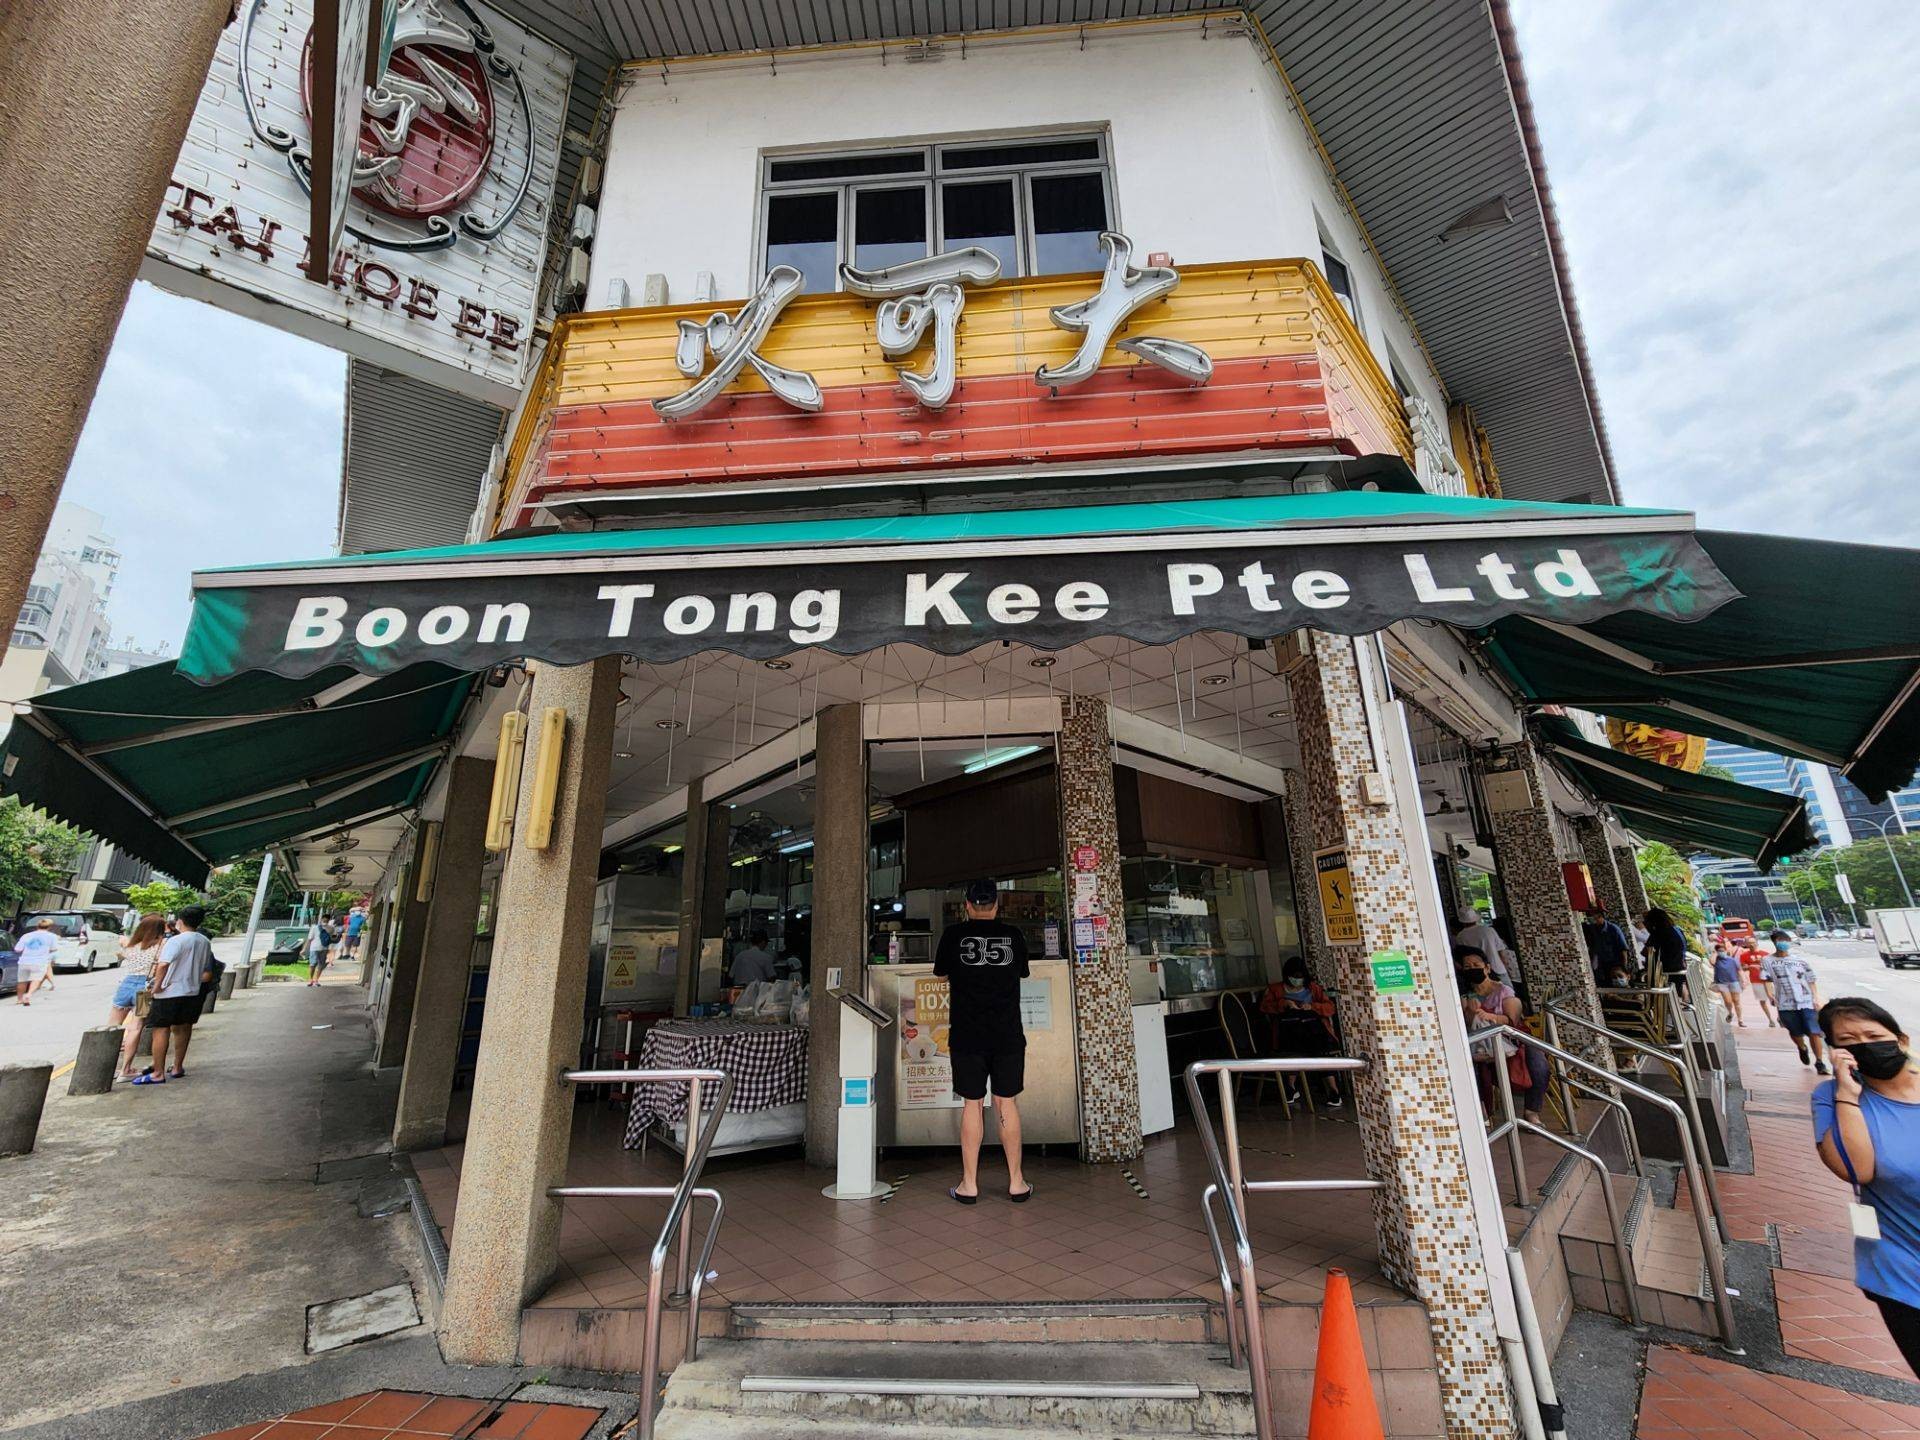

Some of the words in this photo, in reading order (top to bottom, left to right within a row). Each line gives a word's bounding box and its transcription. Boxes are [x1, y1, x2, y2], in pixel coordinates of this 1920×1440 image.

[452, 297, 525, 352] EE
[283, 596, 531, 651] Boon
[596, 583, 841, 644] Tong
[904, 571, 1110, 626] Kee
[1166, 559, 1351, 616] Pte
[1402, 548, 1602, 603] Ltd
[1318, 854, 1346, 869] CAUTION
[918, 993, 951, 1010] 10X
